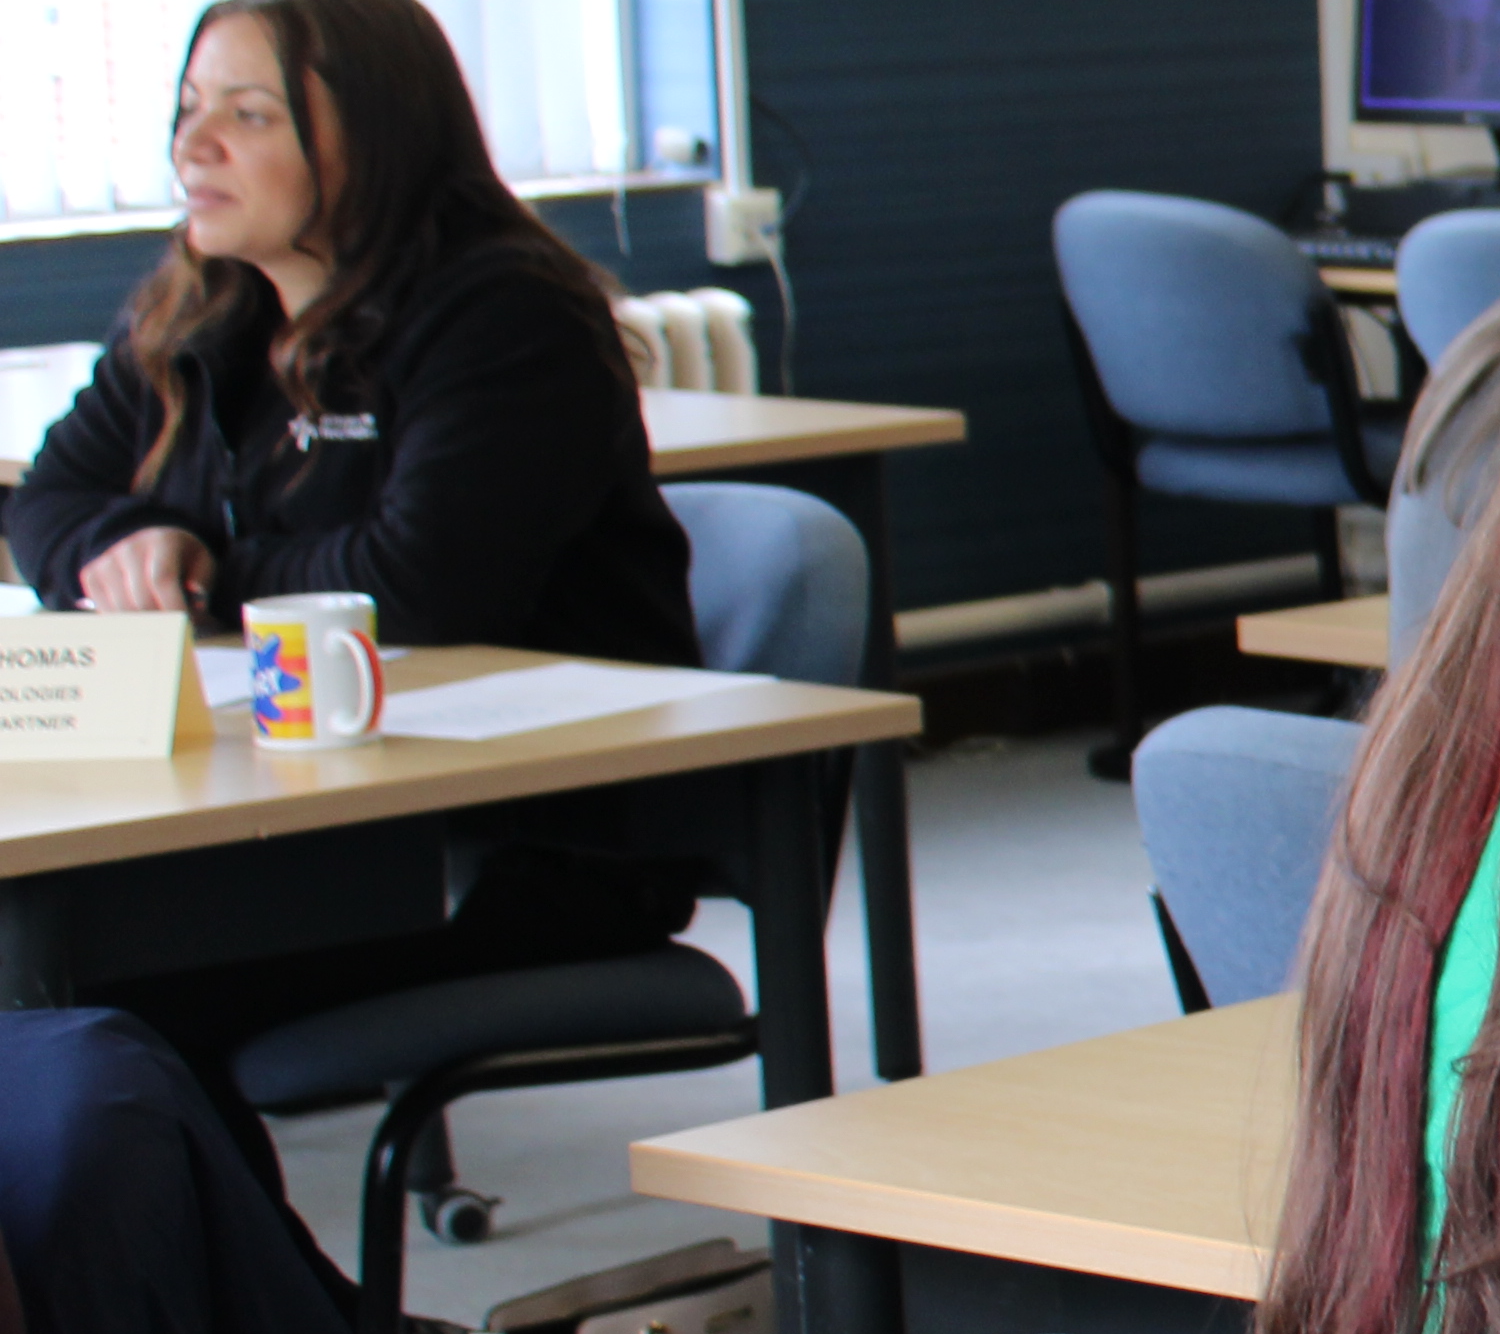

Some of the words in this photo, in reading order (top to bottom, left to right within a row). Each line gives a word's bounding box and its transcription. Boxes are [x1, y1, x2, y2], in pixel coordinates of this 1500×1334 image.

[0, 646, 97, 668] HOMAS
[0, 685, 85, 702] OLOGIES
[0, 714, 79, 731] ARTNER
